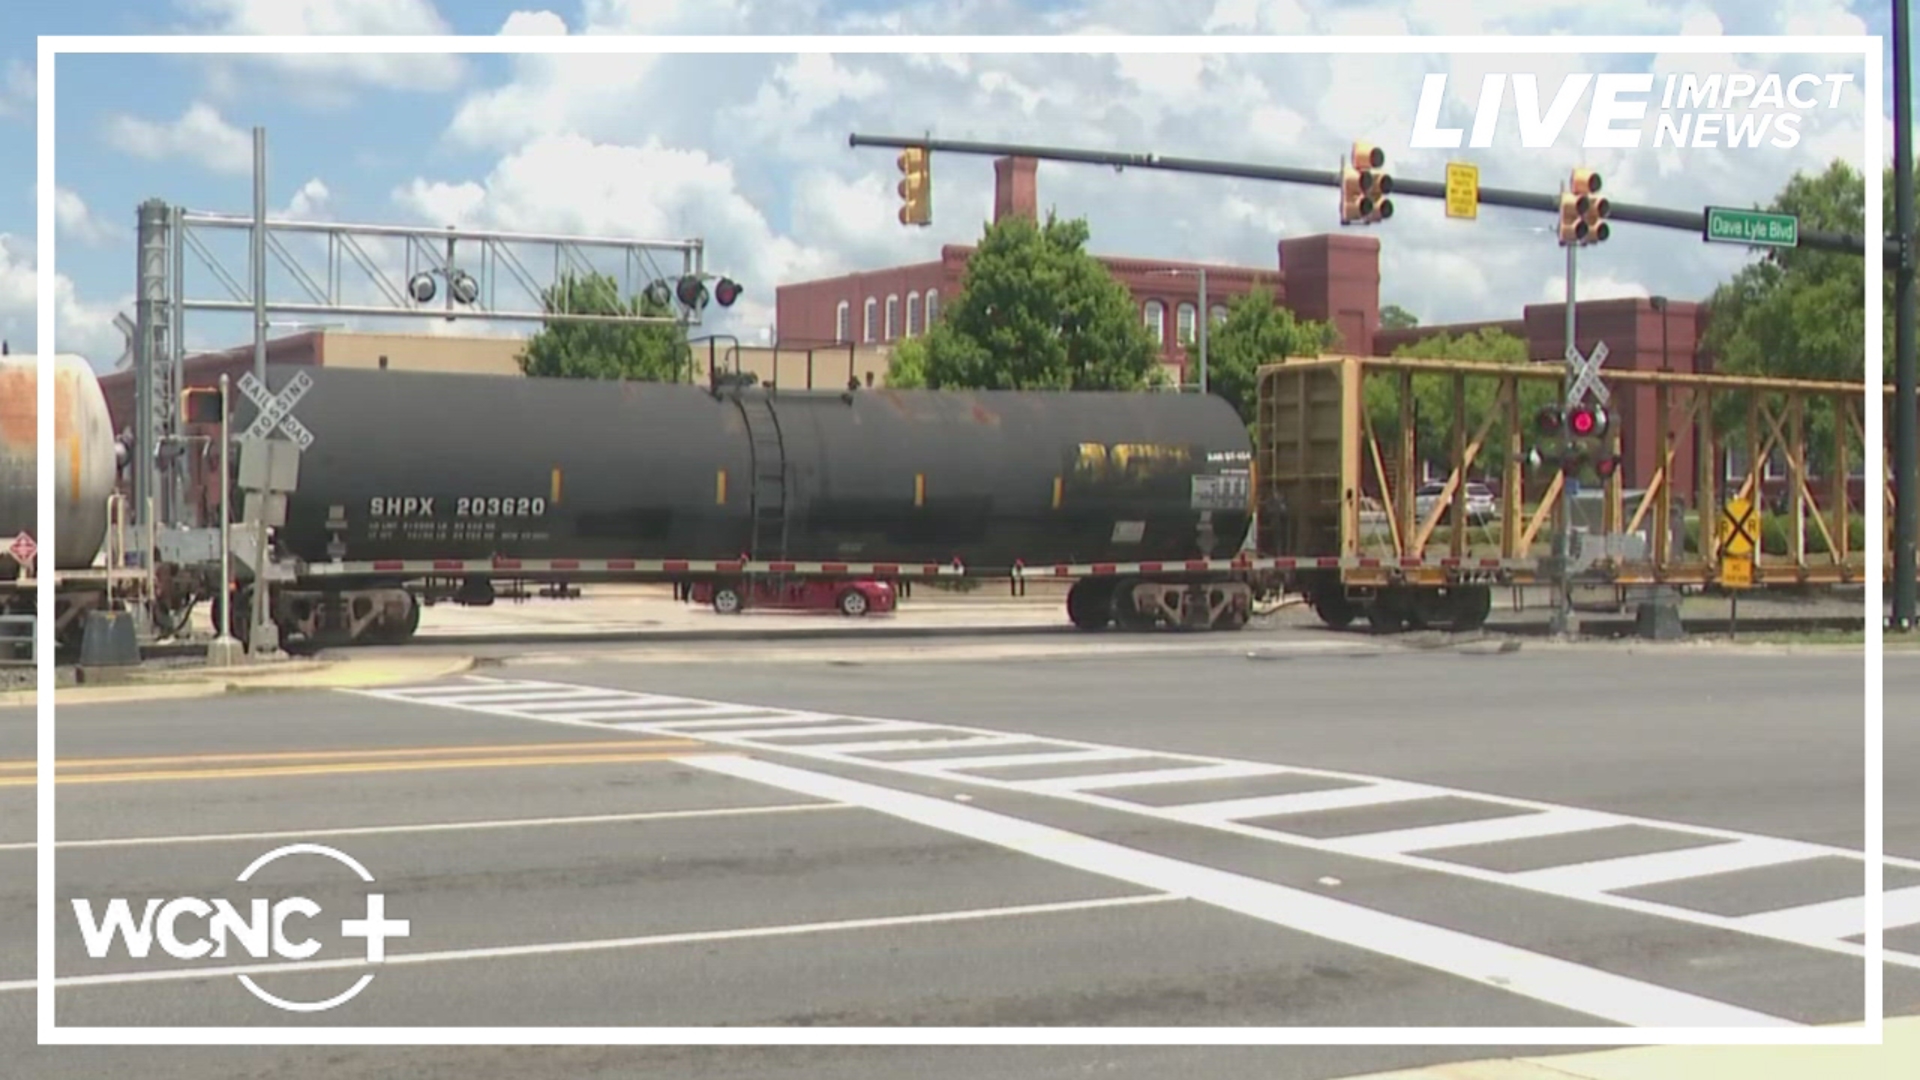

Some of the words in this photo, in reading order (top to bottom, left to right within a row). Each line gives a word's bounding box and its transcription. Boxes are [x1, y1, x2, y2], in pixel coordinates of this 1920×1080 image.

[1712, 216, 1742, 236] Dave
[1744, 219, 1767, 241] Lyle
[1769, 221, 1793, 240] Blvd
[246, 374, 310, 439] ROSSING
[370, 496, 434, 516] SHPX
[456, 496, 546, 516] 203620
